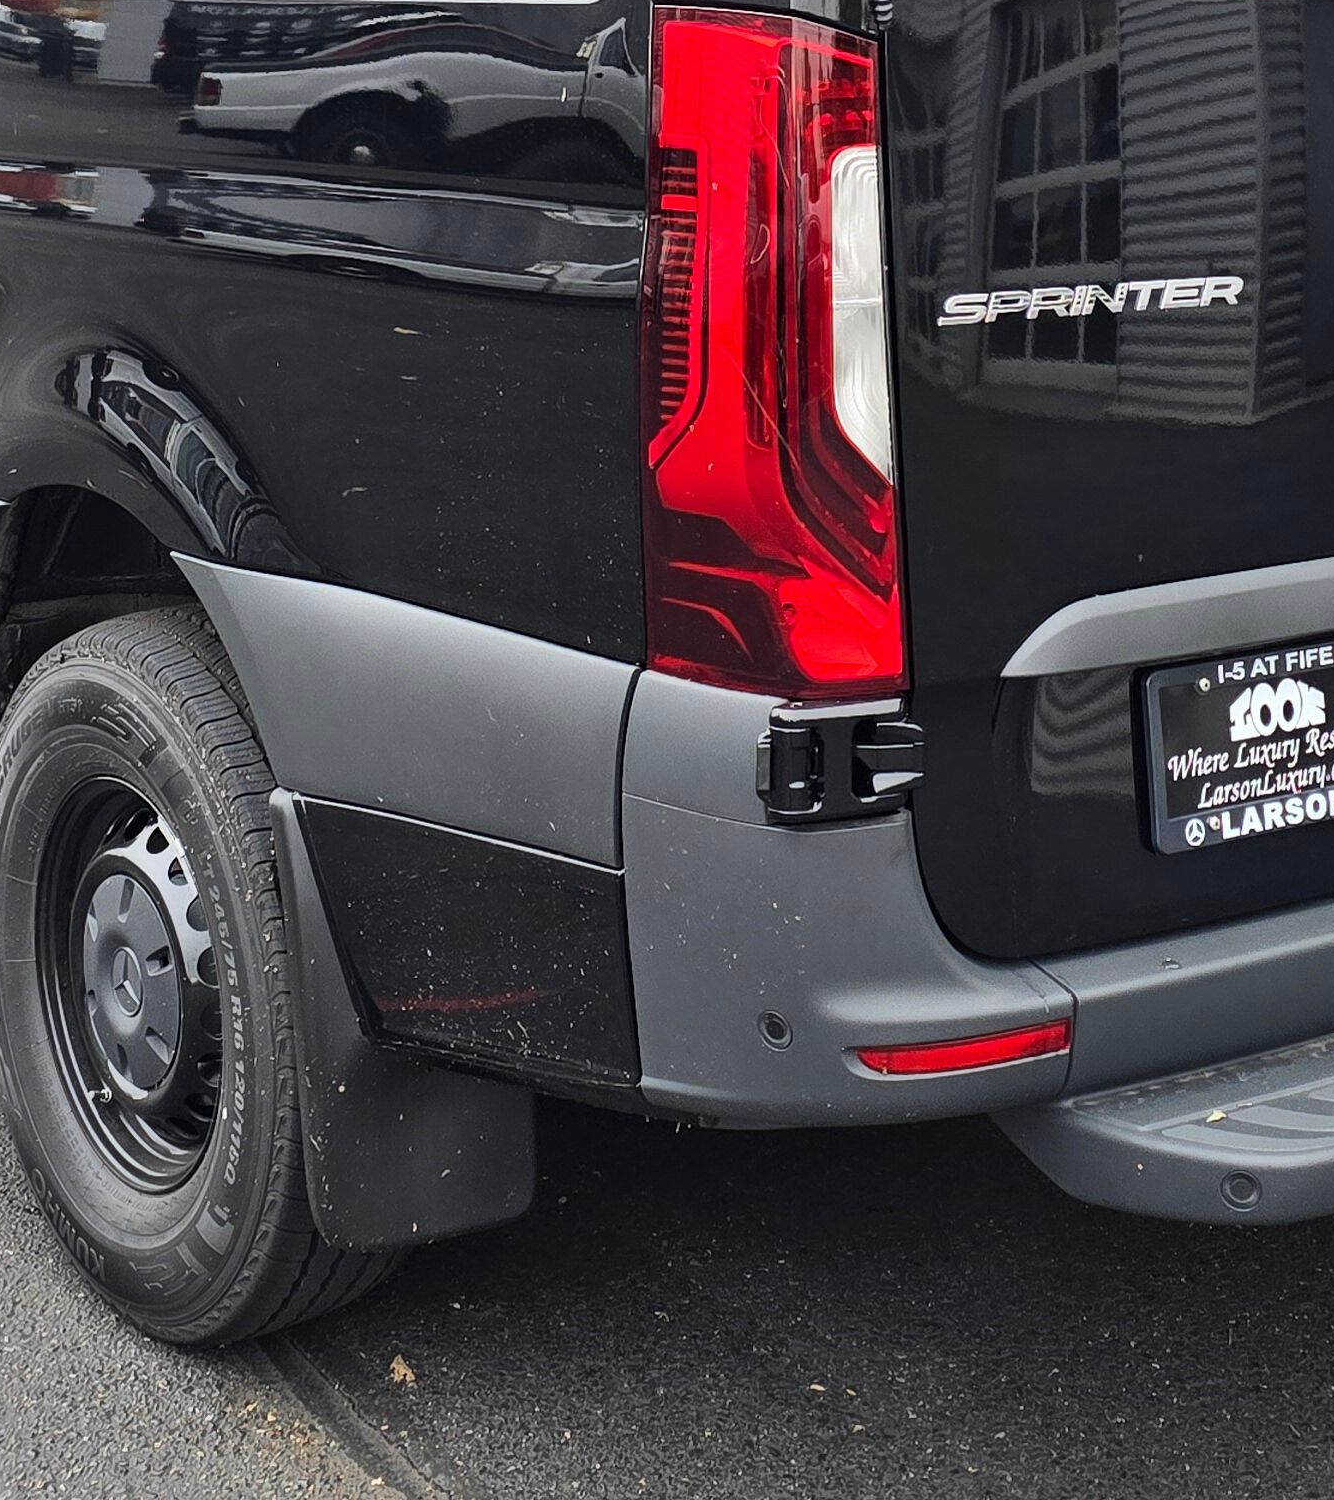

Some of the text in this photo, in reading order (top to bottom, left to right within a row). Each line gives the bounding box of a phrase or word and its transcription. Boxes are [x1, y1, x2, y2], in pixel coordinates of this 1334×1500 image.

[937, 276, 1244, 327] SPRINTER
[1217, 645, 1334, 684] I-5 AT FIFE
[1167, 747, 1230, 782] Where
[1234, 737, 1301, 767] Luxury
